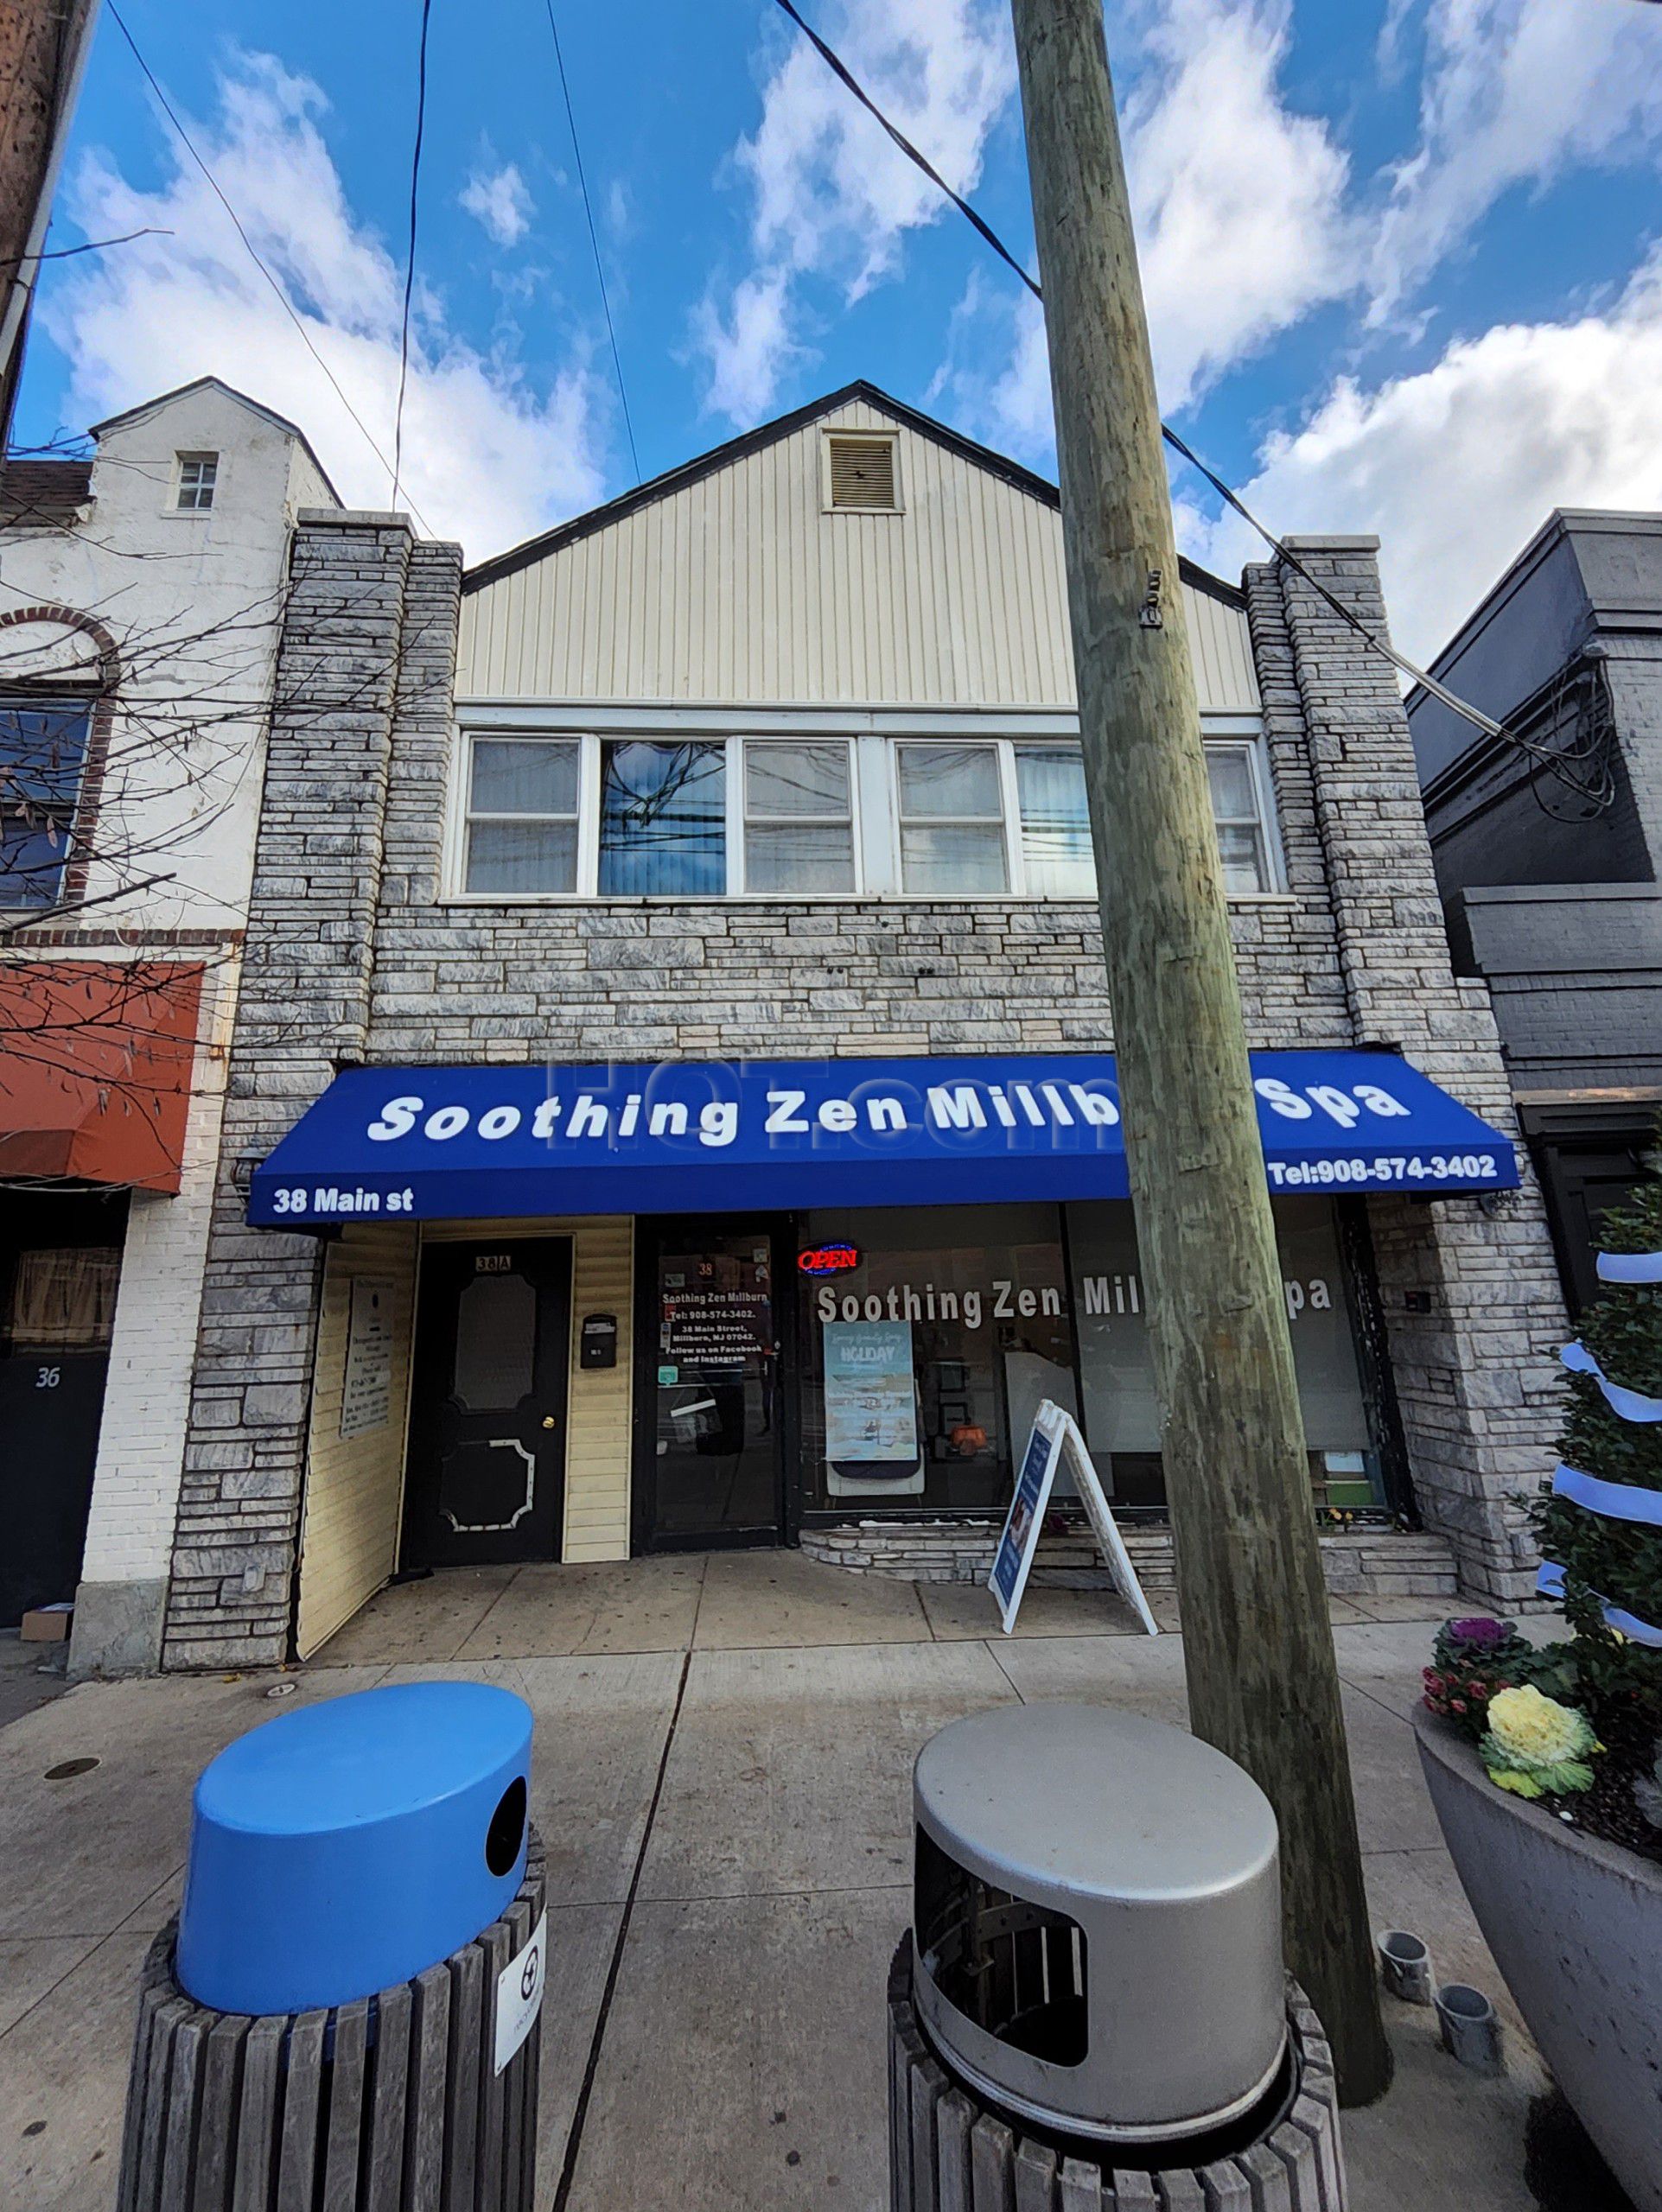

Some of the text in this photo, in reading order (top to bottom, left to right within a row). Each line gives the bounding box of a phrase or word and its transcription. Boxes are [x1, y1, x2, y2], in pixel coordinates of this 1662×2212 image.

[367, 1094, 738, 1147] Soothing
[765, 1090, 907, 1135] Zen
[1253, 1077, 1412, 1128] Spa
[1268, 1154, 1498, 1186] Tel:908-574-3402
[273, 1186, 414, 1214] 38 Main st
[477, 1256, 511, 1270] 38A
[698, 1263, 713, 1276] 38
[798, 1249, 857, 1271] OPEN
[662, 1292, 767, 1305] Soothing Zen Millburn
[818, 1283, 982, 1329] Soothing
[992, 1281, 1061, 1318] Zen
[720, 1344, 762, 1353] Facebook
[840, 1345, 895, 1363] HOLIDAY
[35, 1367, 60, 1388] 36
